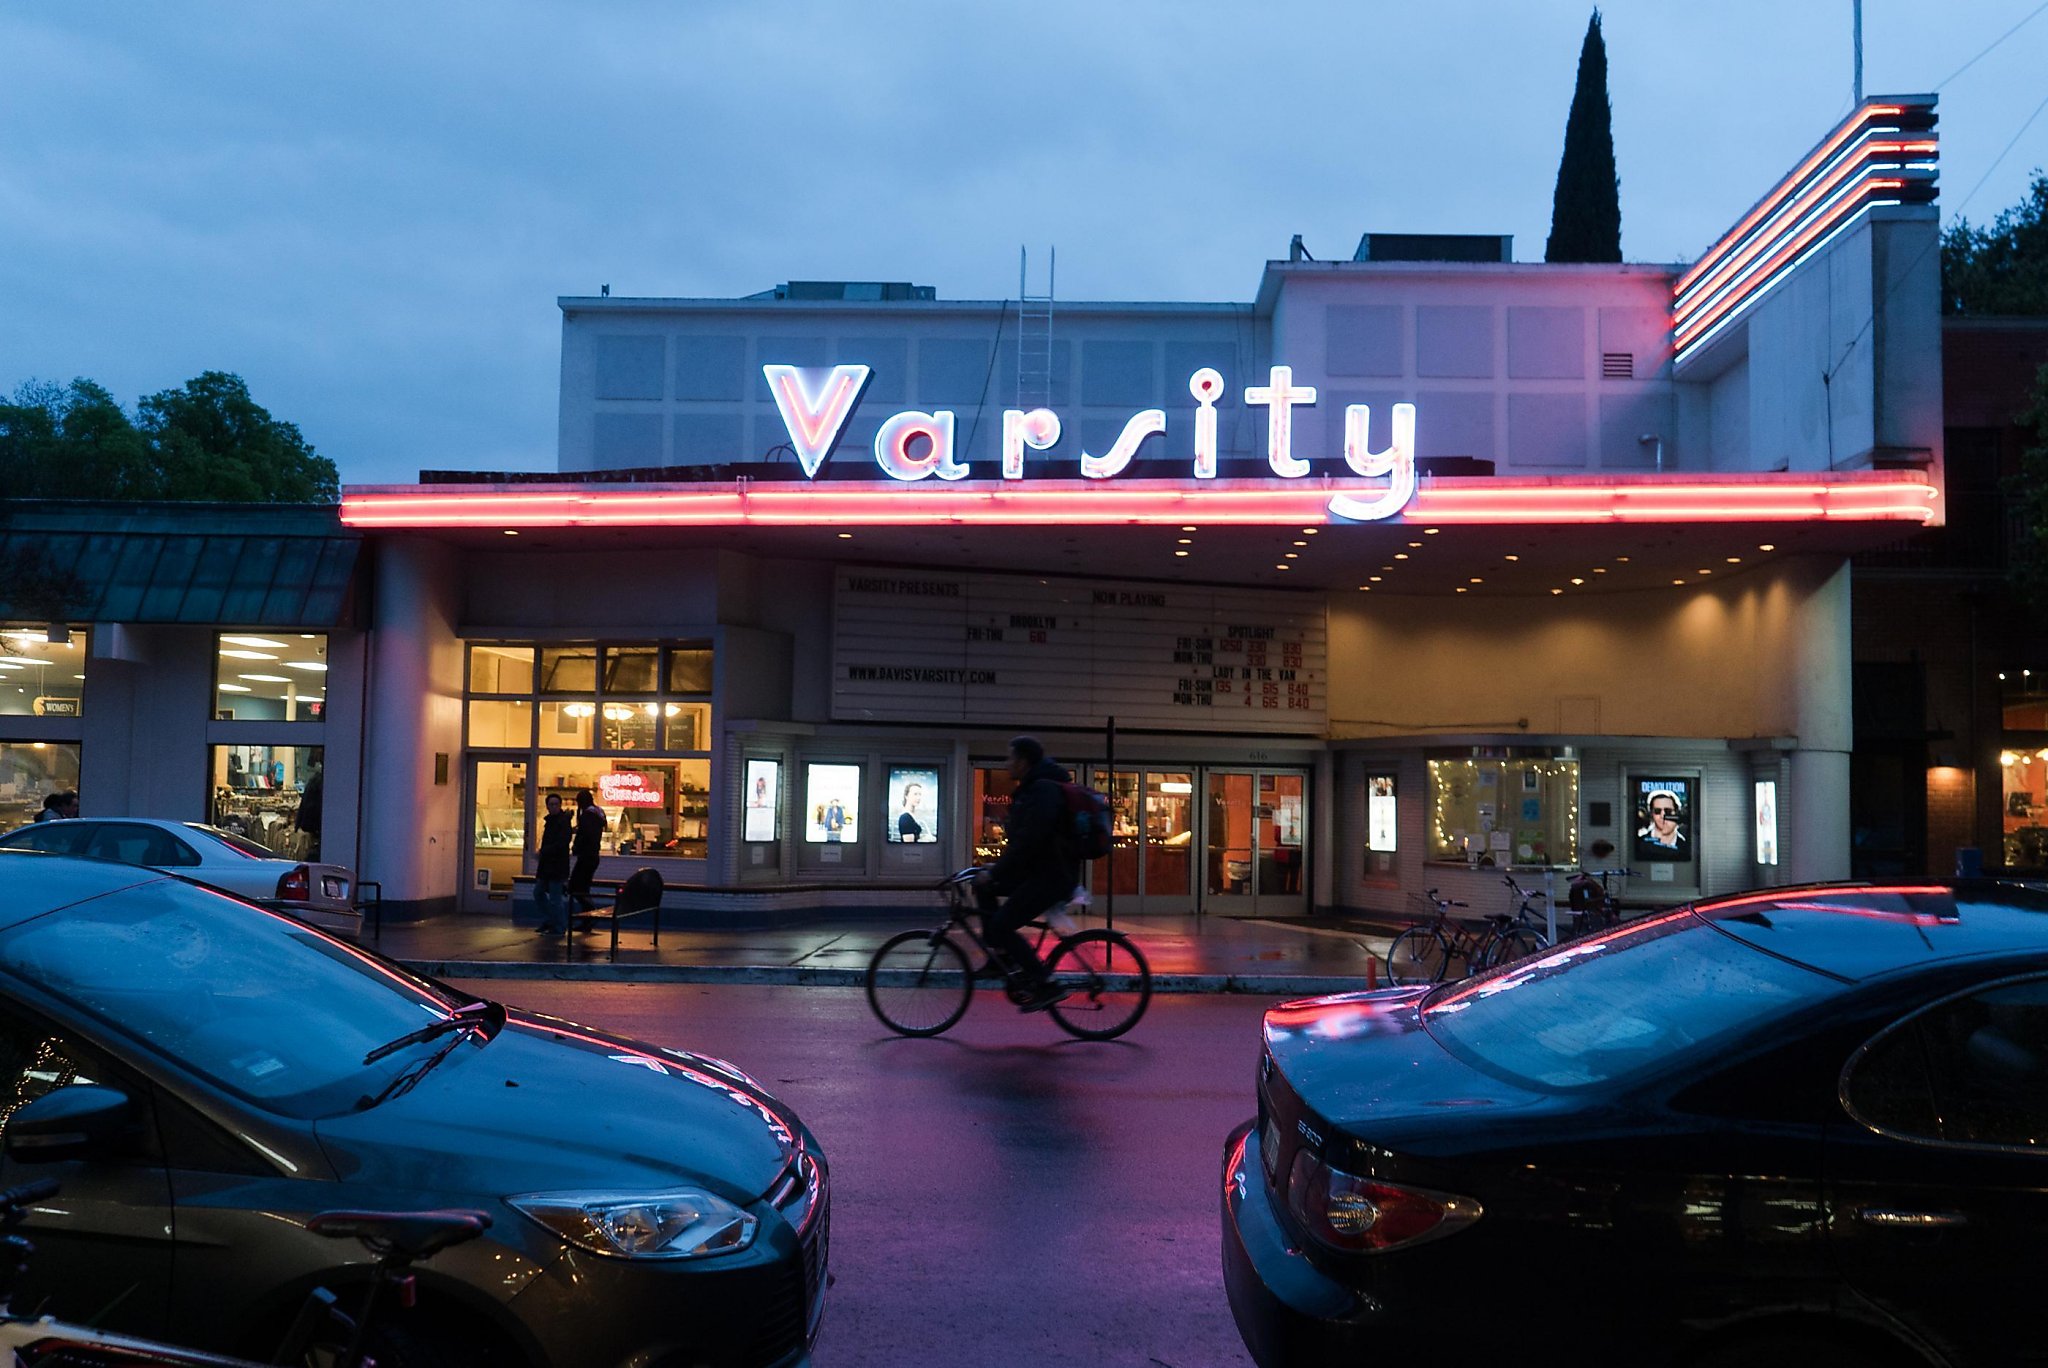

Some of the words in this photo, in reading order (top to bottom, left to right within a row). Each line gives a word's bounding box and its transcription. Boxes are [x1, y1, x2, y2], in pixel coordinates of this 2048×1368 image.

[763, 364, 1416, 522] Varsity
[848, 577, 897, 593] VARSITY
[898, 580, 960, 597] PRESENTS
[1093, 590, 1117, 605] NOW
[1120, 592, 1165, 607] PLAYING
[1010, 615, 1056, 629] BROOKLYN
[967, 627, 1003, 641] FRI-THU
[1228, 625, 1275, 639] SPOTLIGHT
[1177, 637, 1212, 650] FRI-SUN
[1174, 652, 1212, 665] MON-THU
[1247, 654, 1266, 667] 330
[848, 666, 996, 684] WWW.DAVISVARSITY.COM
[1213, 667, 1234, 679] LADY
[1242, 668, 1251, 680] IN
[1257, 668, 1272, 681] THE
[1279, 669, 1296, 681] VAN
[1178, 679, 1212, 691] FRI-SUN
[1244, 681, 1251, 693] 4
[1173, 692, 1212, 705] MON-THU
[1245, 695, 1251, 707] 4
[1263, 696, 1278, 708] 615
[1288, 697, 1309, 709] 840
[1641, 781, 1685, 793] DEMOLITION
